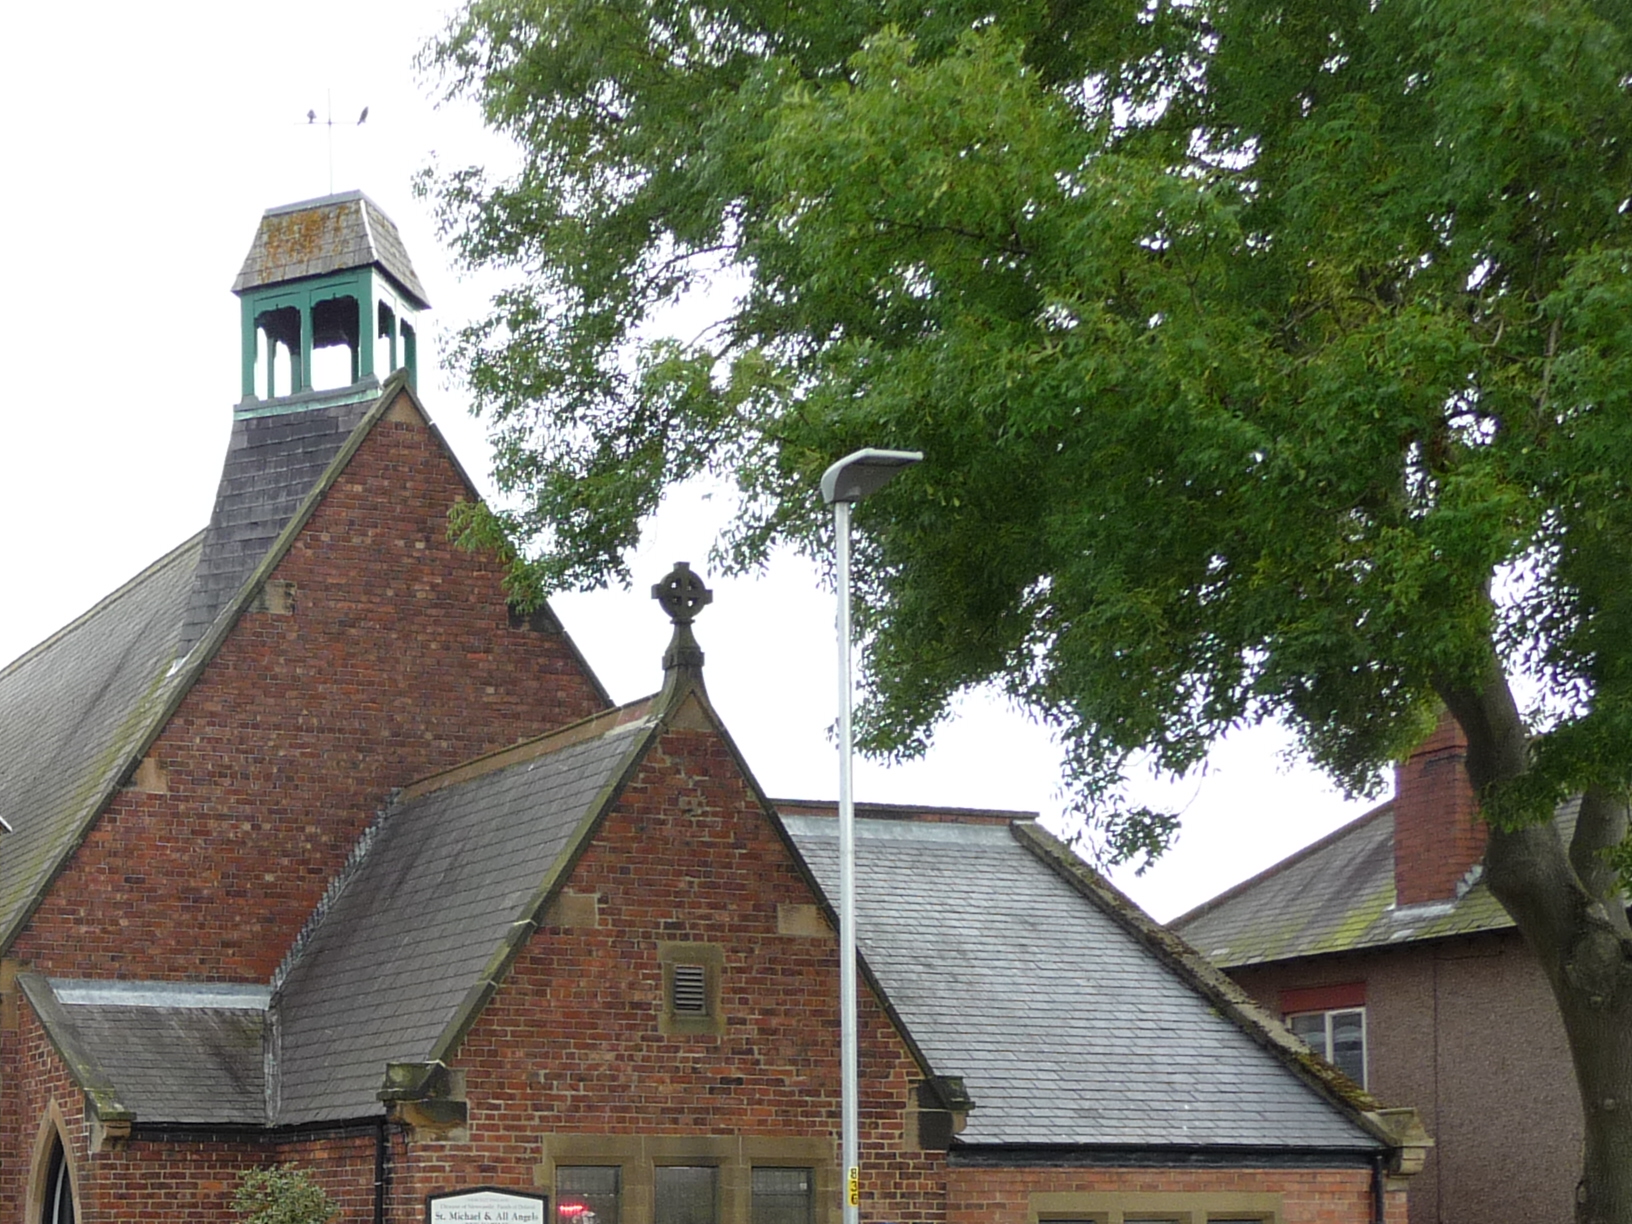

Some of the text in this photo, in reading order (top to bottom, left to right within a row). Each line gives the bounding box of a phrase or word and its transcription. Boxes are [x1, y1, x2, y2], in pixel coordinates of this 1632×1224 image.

[435, 1212, 538, 1222] St. Michael & All Angels
